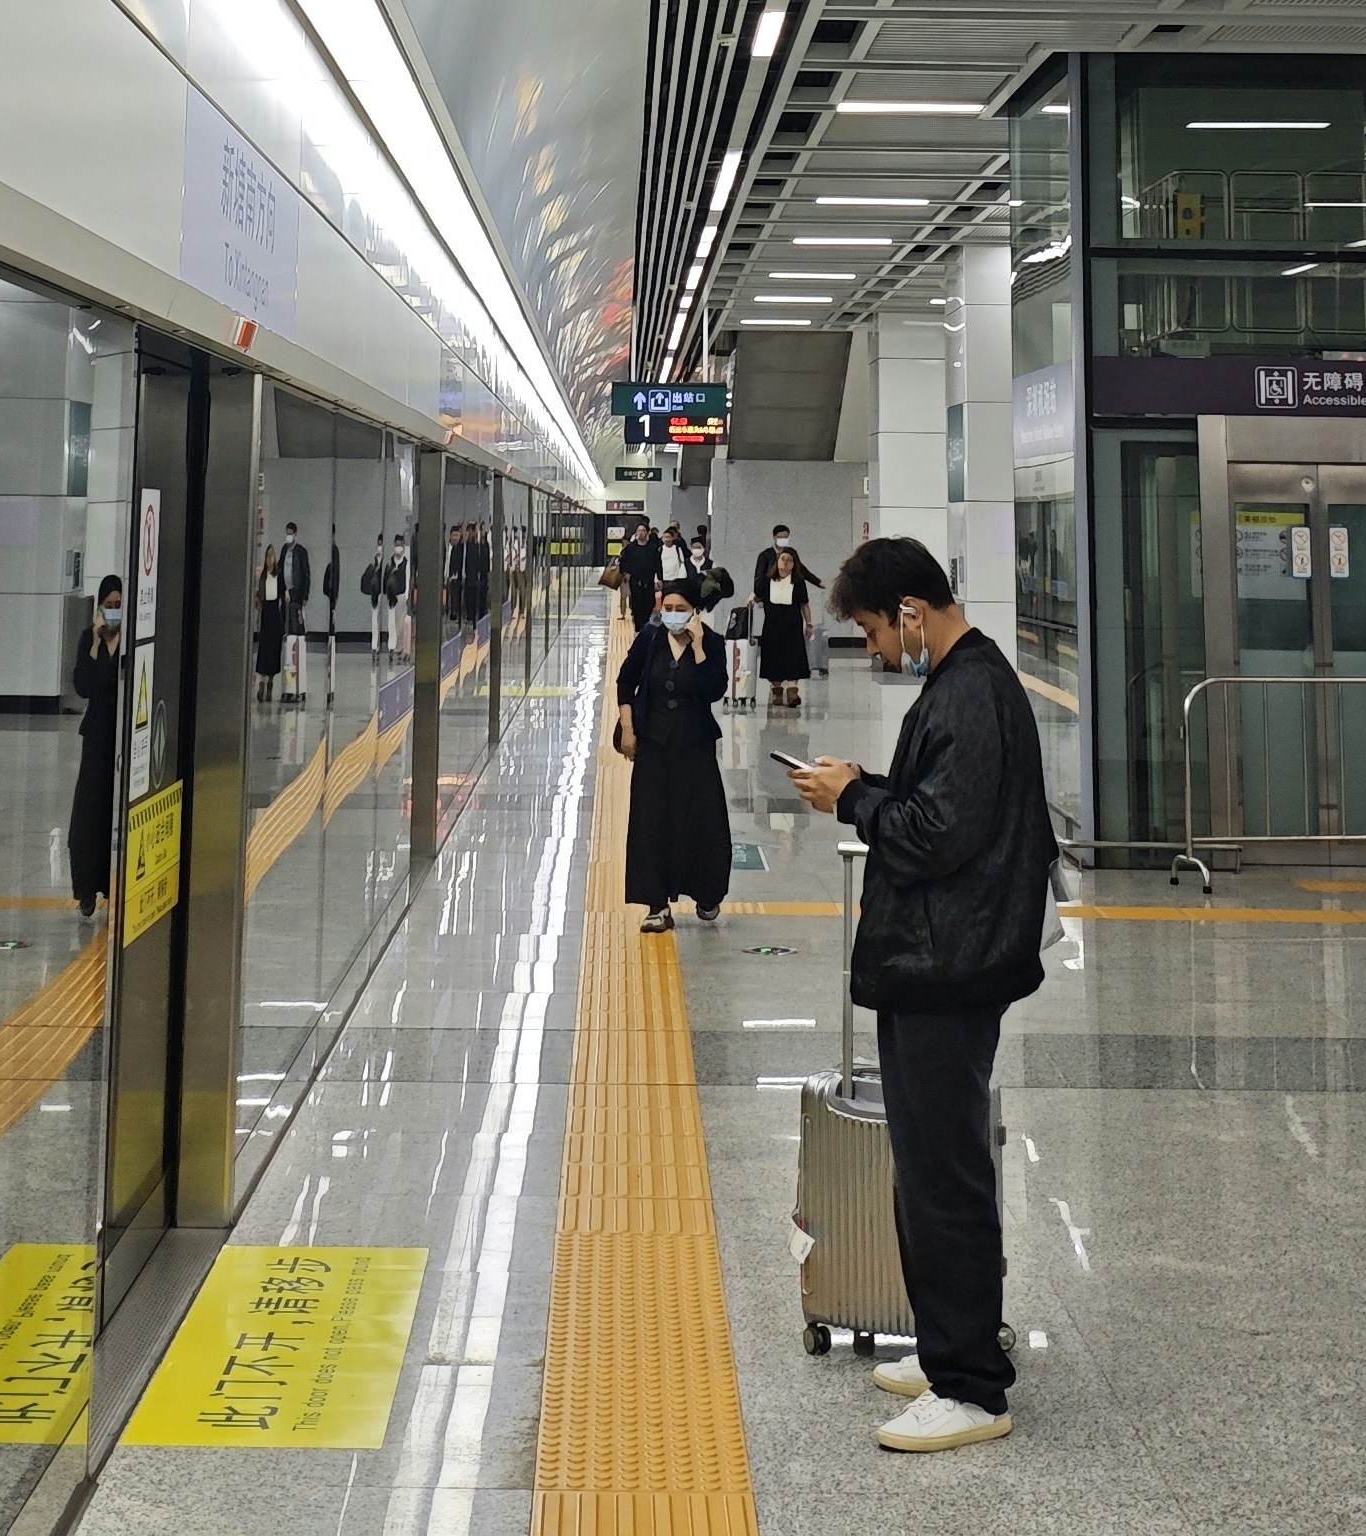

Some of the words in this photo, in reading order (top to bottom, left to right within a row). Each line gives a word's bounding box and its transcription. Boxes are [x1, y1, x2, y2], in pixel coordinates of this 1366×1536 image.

[221, 137, 276, 255] 新塘南方向
[638, 414, 651, 438] 1
[323, 1347, 343, 1360] not
[310, 1364, 337, 1384] does
[302, 1388, 329, 1408] door
[292, 1411, 322, 1432] This
